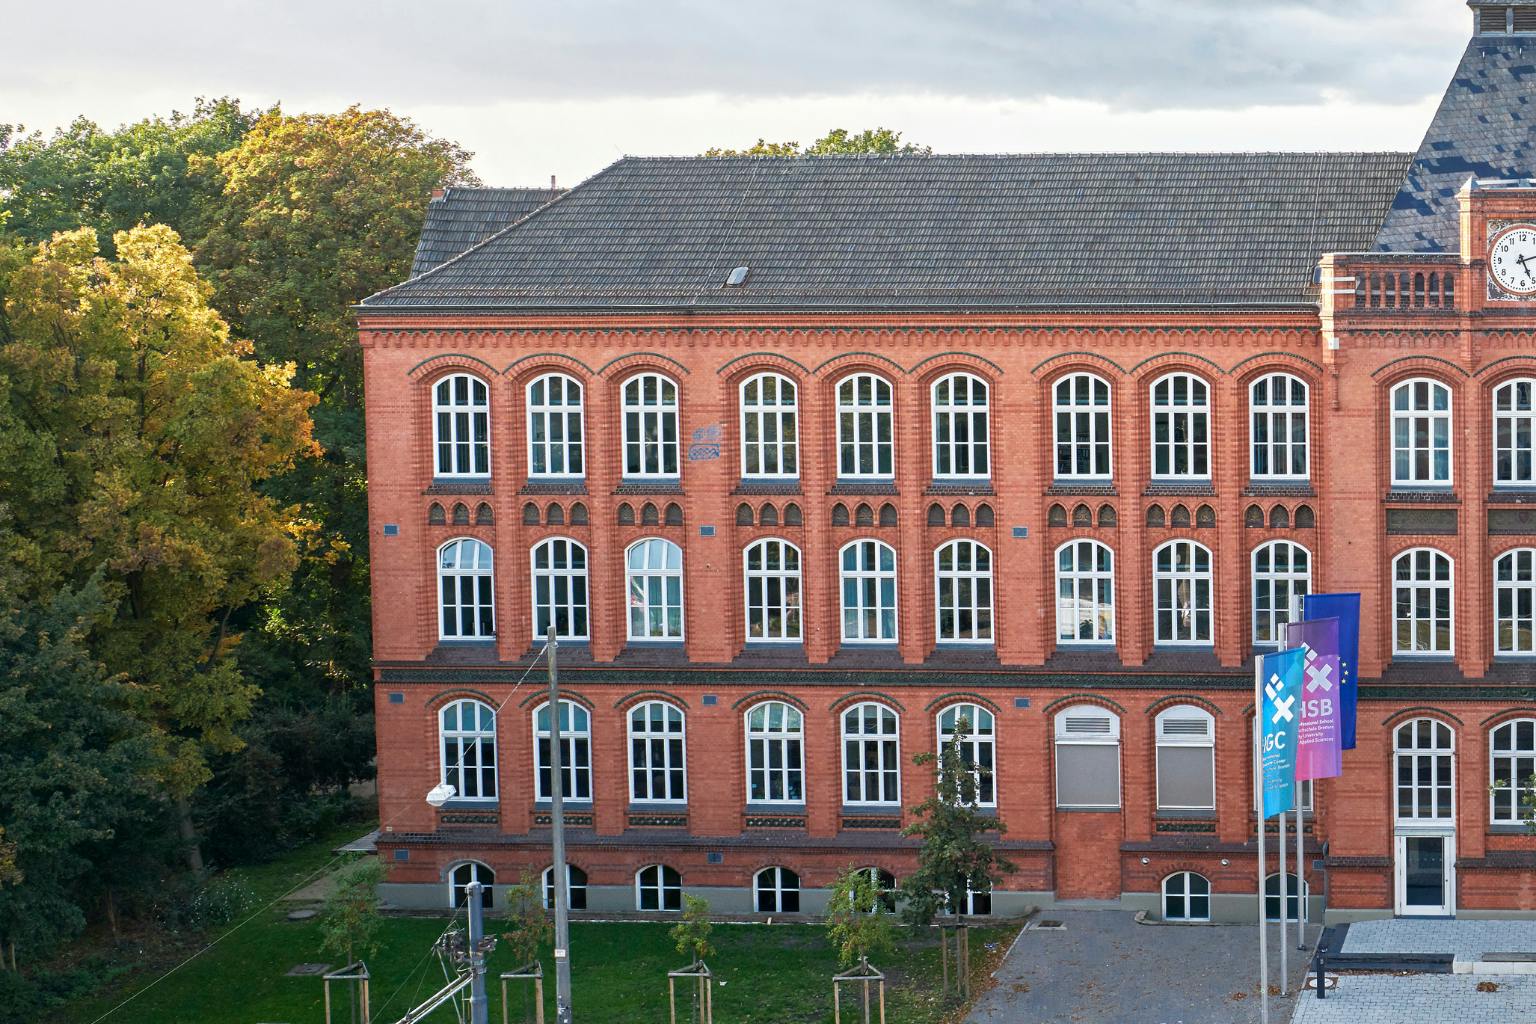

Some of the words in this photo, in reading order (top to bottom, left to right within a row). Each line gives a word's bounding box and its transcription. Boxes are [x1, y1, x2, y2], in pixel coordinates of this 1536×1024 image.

[1509, 237, 1515, 245] 11
[1519, 234, 1527, 242] 12
[1501, 245, 1509, 253] 10
[1520, 279, 1525, 287] 6
[1531, 277, 1536, 285] 5
